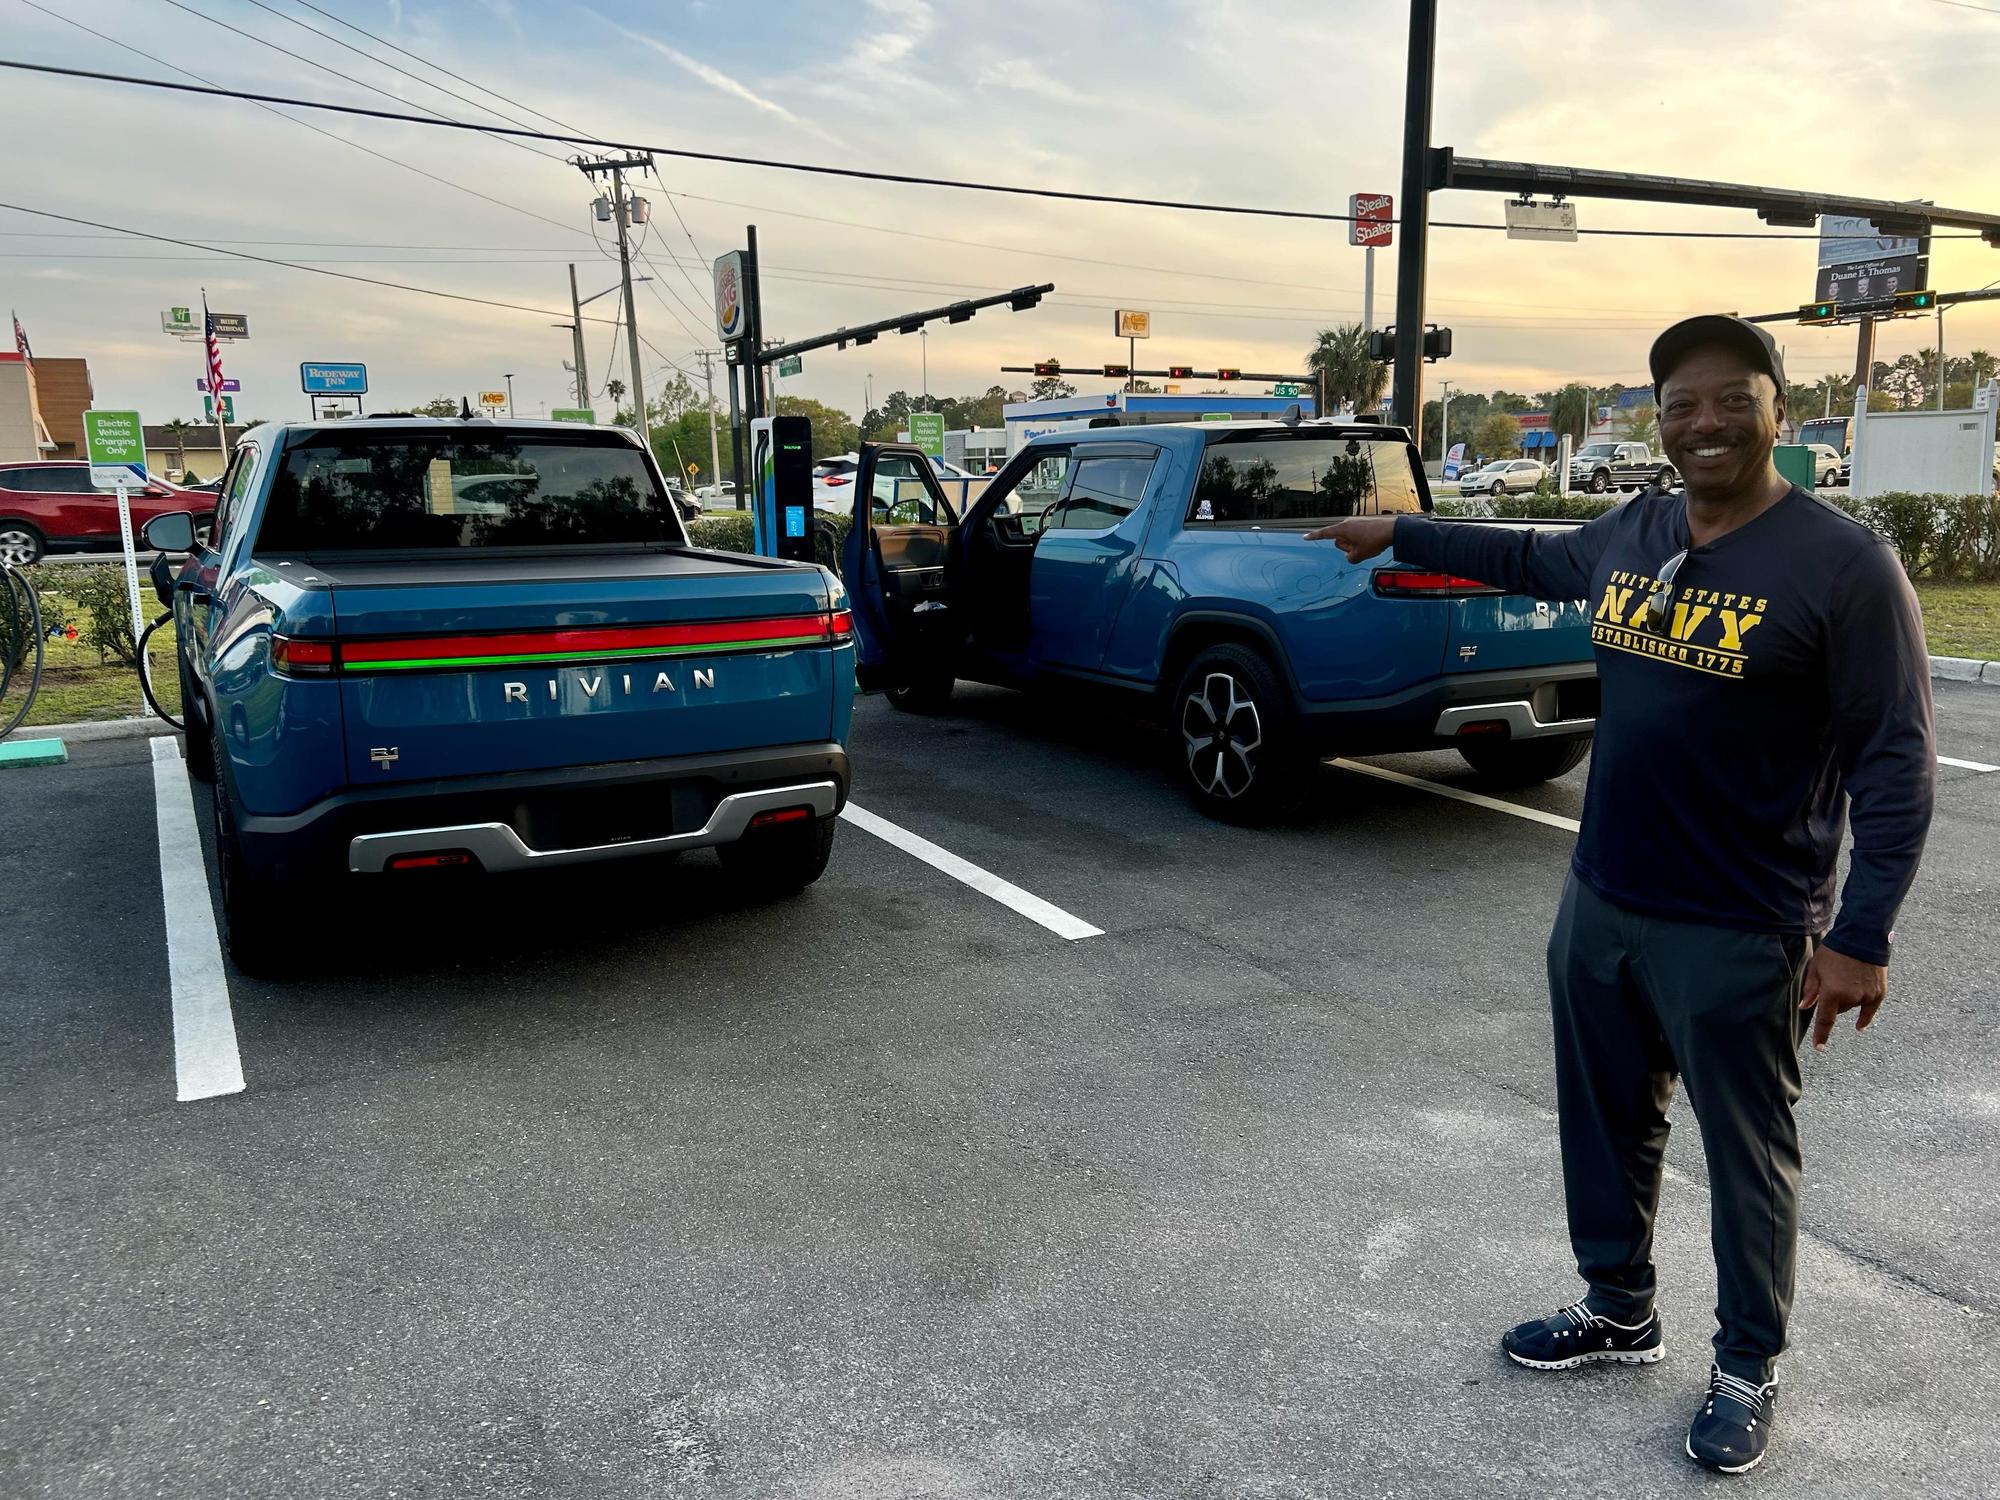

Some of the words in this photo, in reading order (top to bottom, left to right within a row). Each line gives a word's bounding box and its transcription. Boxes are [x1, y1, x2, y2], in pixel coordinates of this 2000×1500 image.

[1357, 196, 1391, 216] Steak
[1356, 223, 1392, 243] Shake
[1831, 271, 1858, 281] Duane
[1868, 266, 1902, 276] Thomas
[308, 368, 361, 378] RODEWAY
[325, 378, 346, 387] INN
[1276, 386, 1286, 395] US
[1288, 387, 1298, 395] 90
[97, 419, 132, 427] Electric
[95, 438, 136, 447] Charging
[914, 435, 940, 443] Charging
[106, 446, 128, 455] Only
[1610, 570, 1673, 597] UNITED
[1682, 587, 1768, 613] STATES
[1535, 600, 1588, 618] RIV
[1595, 584, 1763, 651] NAVY
[1591, 626, 1688, 662] ESTABLISHED
[1696, 652, 1744, 674] 1775
[503, 668, 716, 703] RIVIAN
